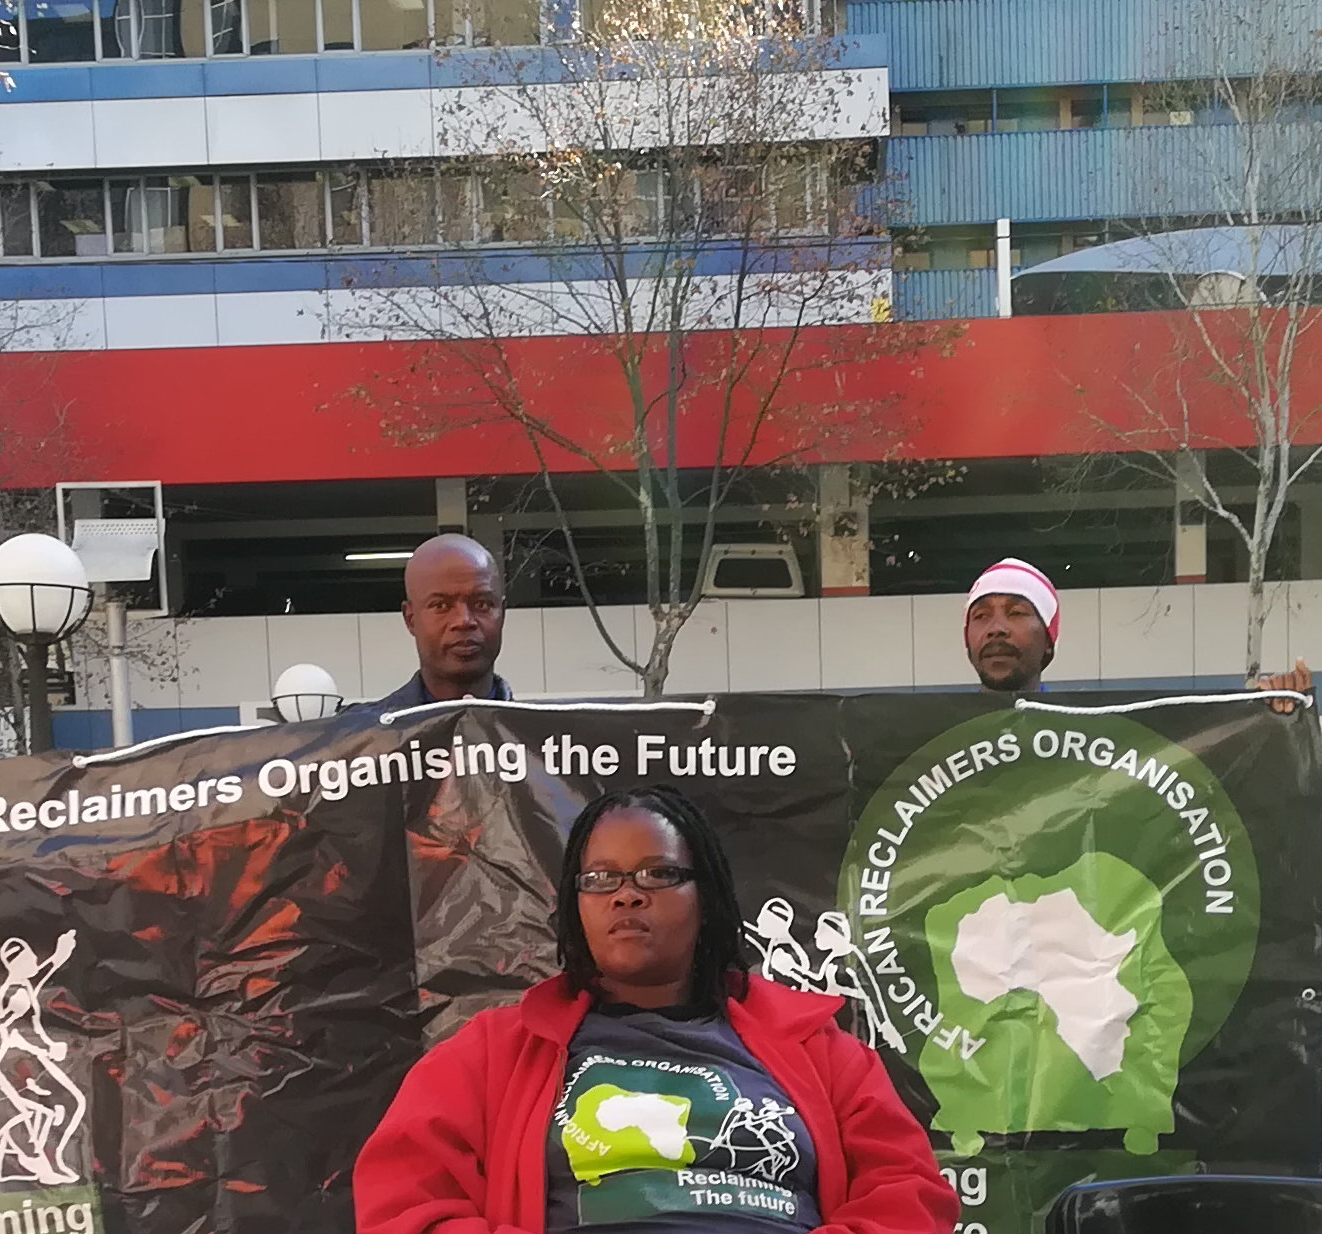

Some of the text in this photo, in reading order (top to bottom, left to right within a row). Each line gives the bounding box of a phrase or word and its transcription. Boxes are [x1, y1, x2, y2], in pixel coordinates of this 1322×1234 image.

[258, 736, 528, 800] Organising
[540, 736, 620, 776] the
[638, 735, 797, 776] Future
[860, 730, 1234, 1059] AFRICAN RECLAIMERS ORGANISATION
[631, 1059, 729, 1101] ORGANISATION
[690, 1190, 795, 1216] The future
